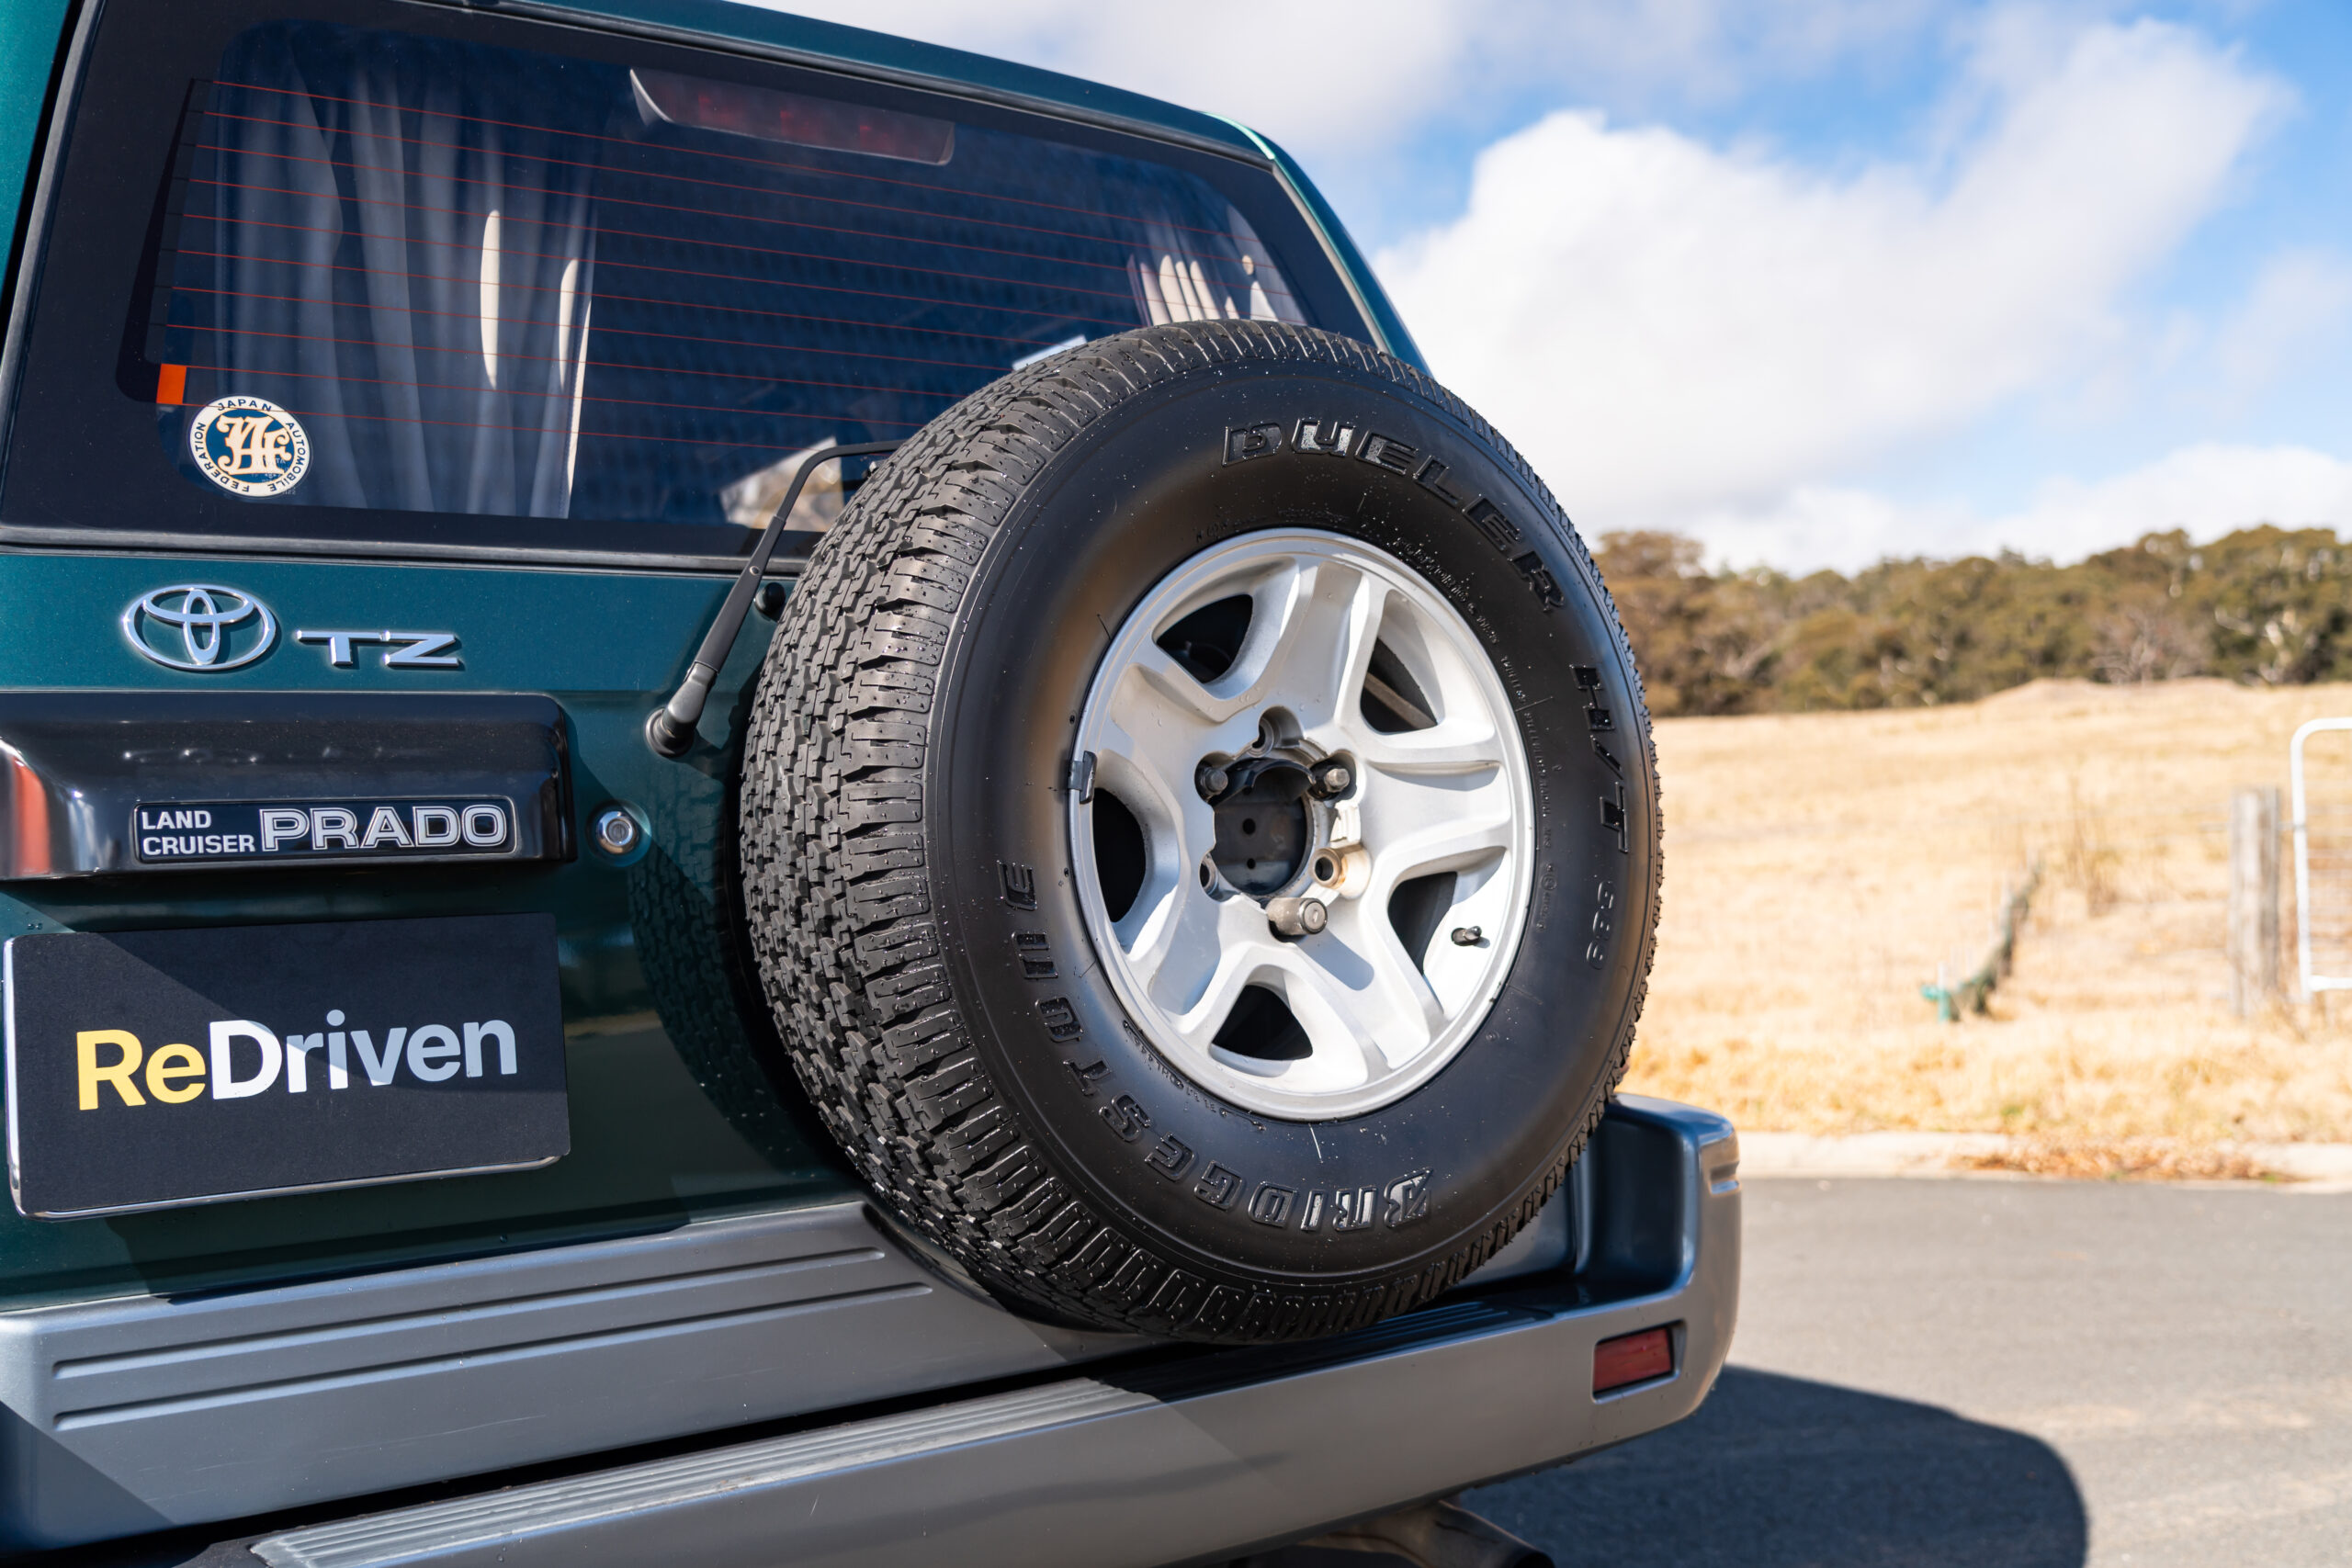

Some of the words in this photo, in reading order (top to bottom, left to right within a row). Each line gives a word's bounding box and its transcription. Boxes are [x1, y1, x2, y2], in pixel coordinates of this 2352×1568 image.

[217, 399, 272, 412] JAPAN
[194, 422, 250, 493] FEDERATION
[267, 422, 306, 491] AUTOMOBILE
[1222, 418, 1565, 614] DUELER
[297, 629, 461, 668] TZ
[1569, 663, 1628, 853] H/T
[141, 809, 211, 830] LAND
[142, 834, 255, 856] CRUISER
[259, 804, 508, 852] PRADO
[1585, 880, 1615, 970] 689
[76, 1009, 518, 1111] ReDriven
[997, 860, 1435, 1232] BRIDGESTONE
